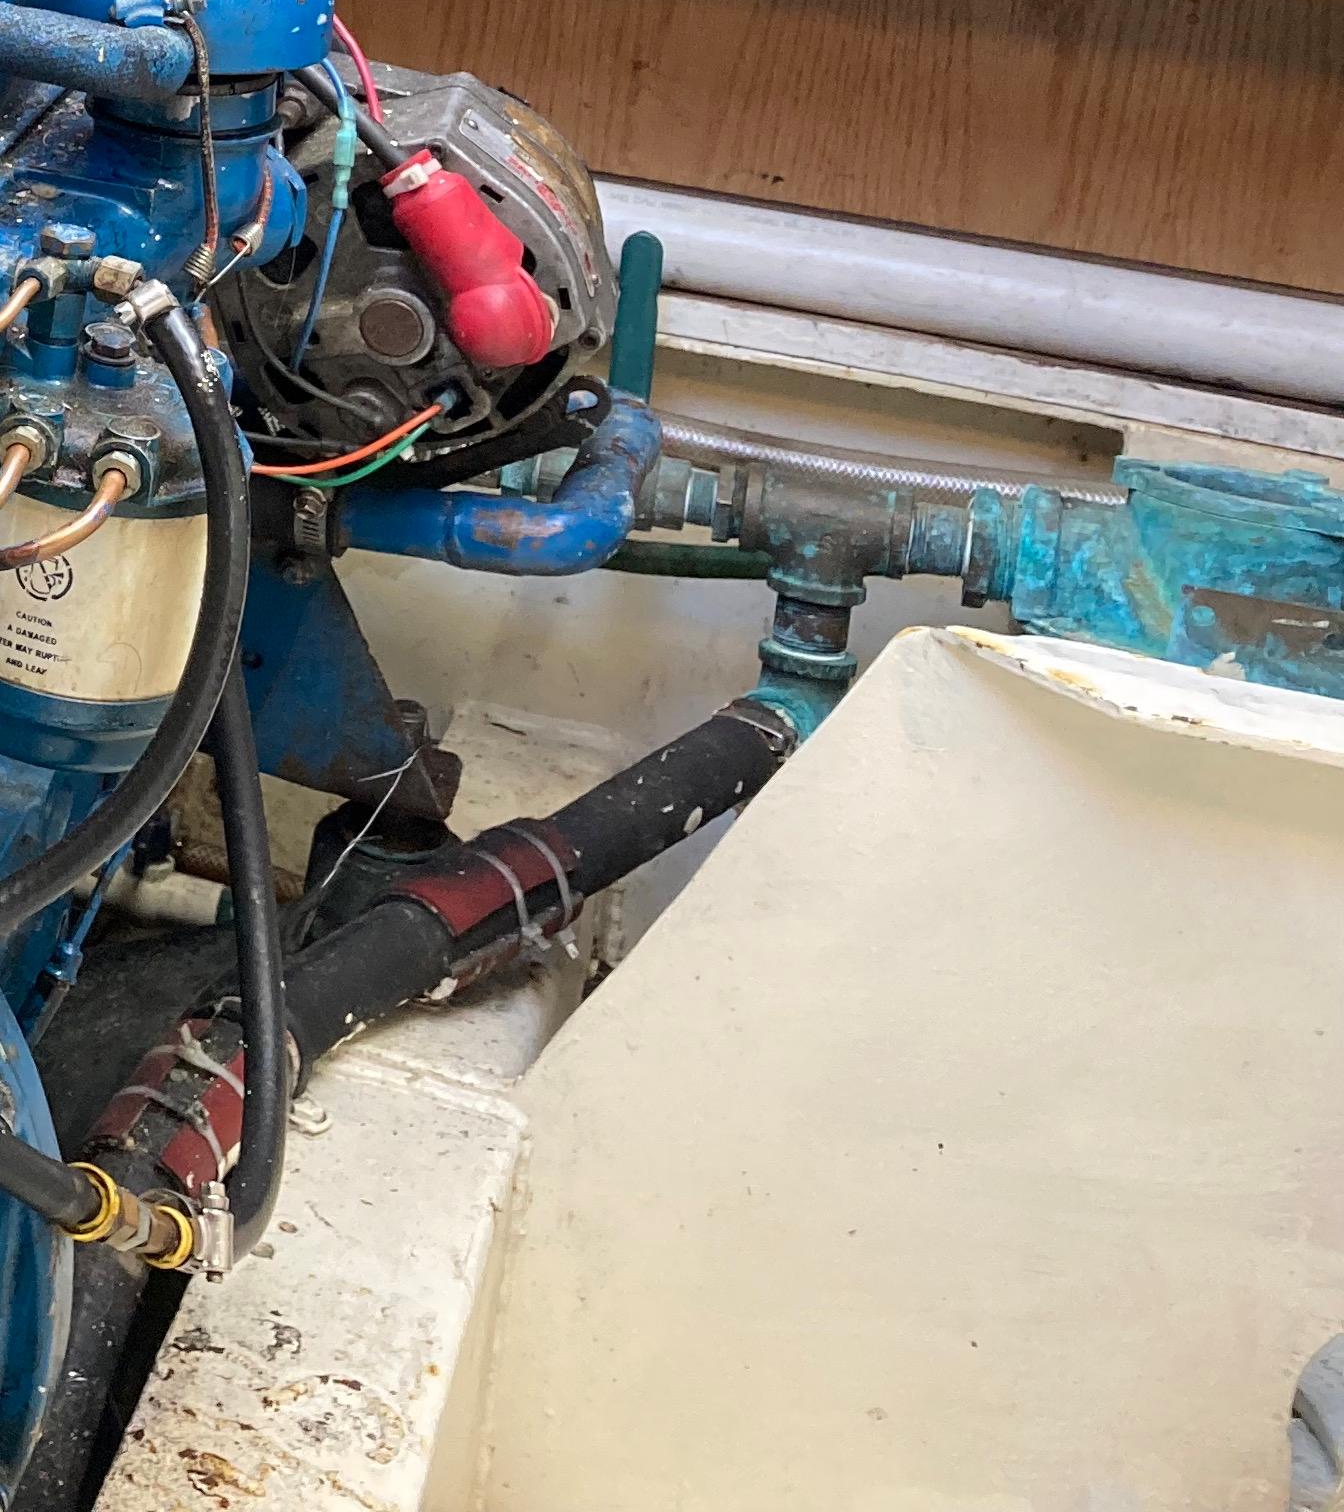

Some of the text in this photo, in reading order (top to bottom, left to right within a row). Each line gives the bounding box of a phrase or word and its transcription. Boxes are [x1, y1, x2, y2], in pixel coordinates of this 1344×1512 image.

[15, 610, 53, 628] CAUTION
[6, 623, 58, 646] A DAMAGED
[15, 643, 34, 656] MAY
[5, 657, 23, 668] AND
